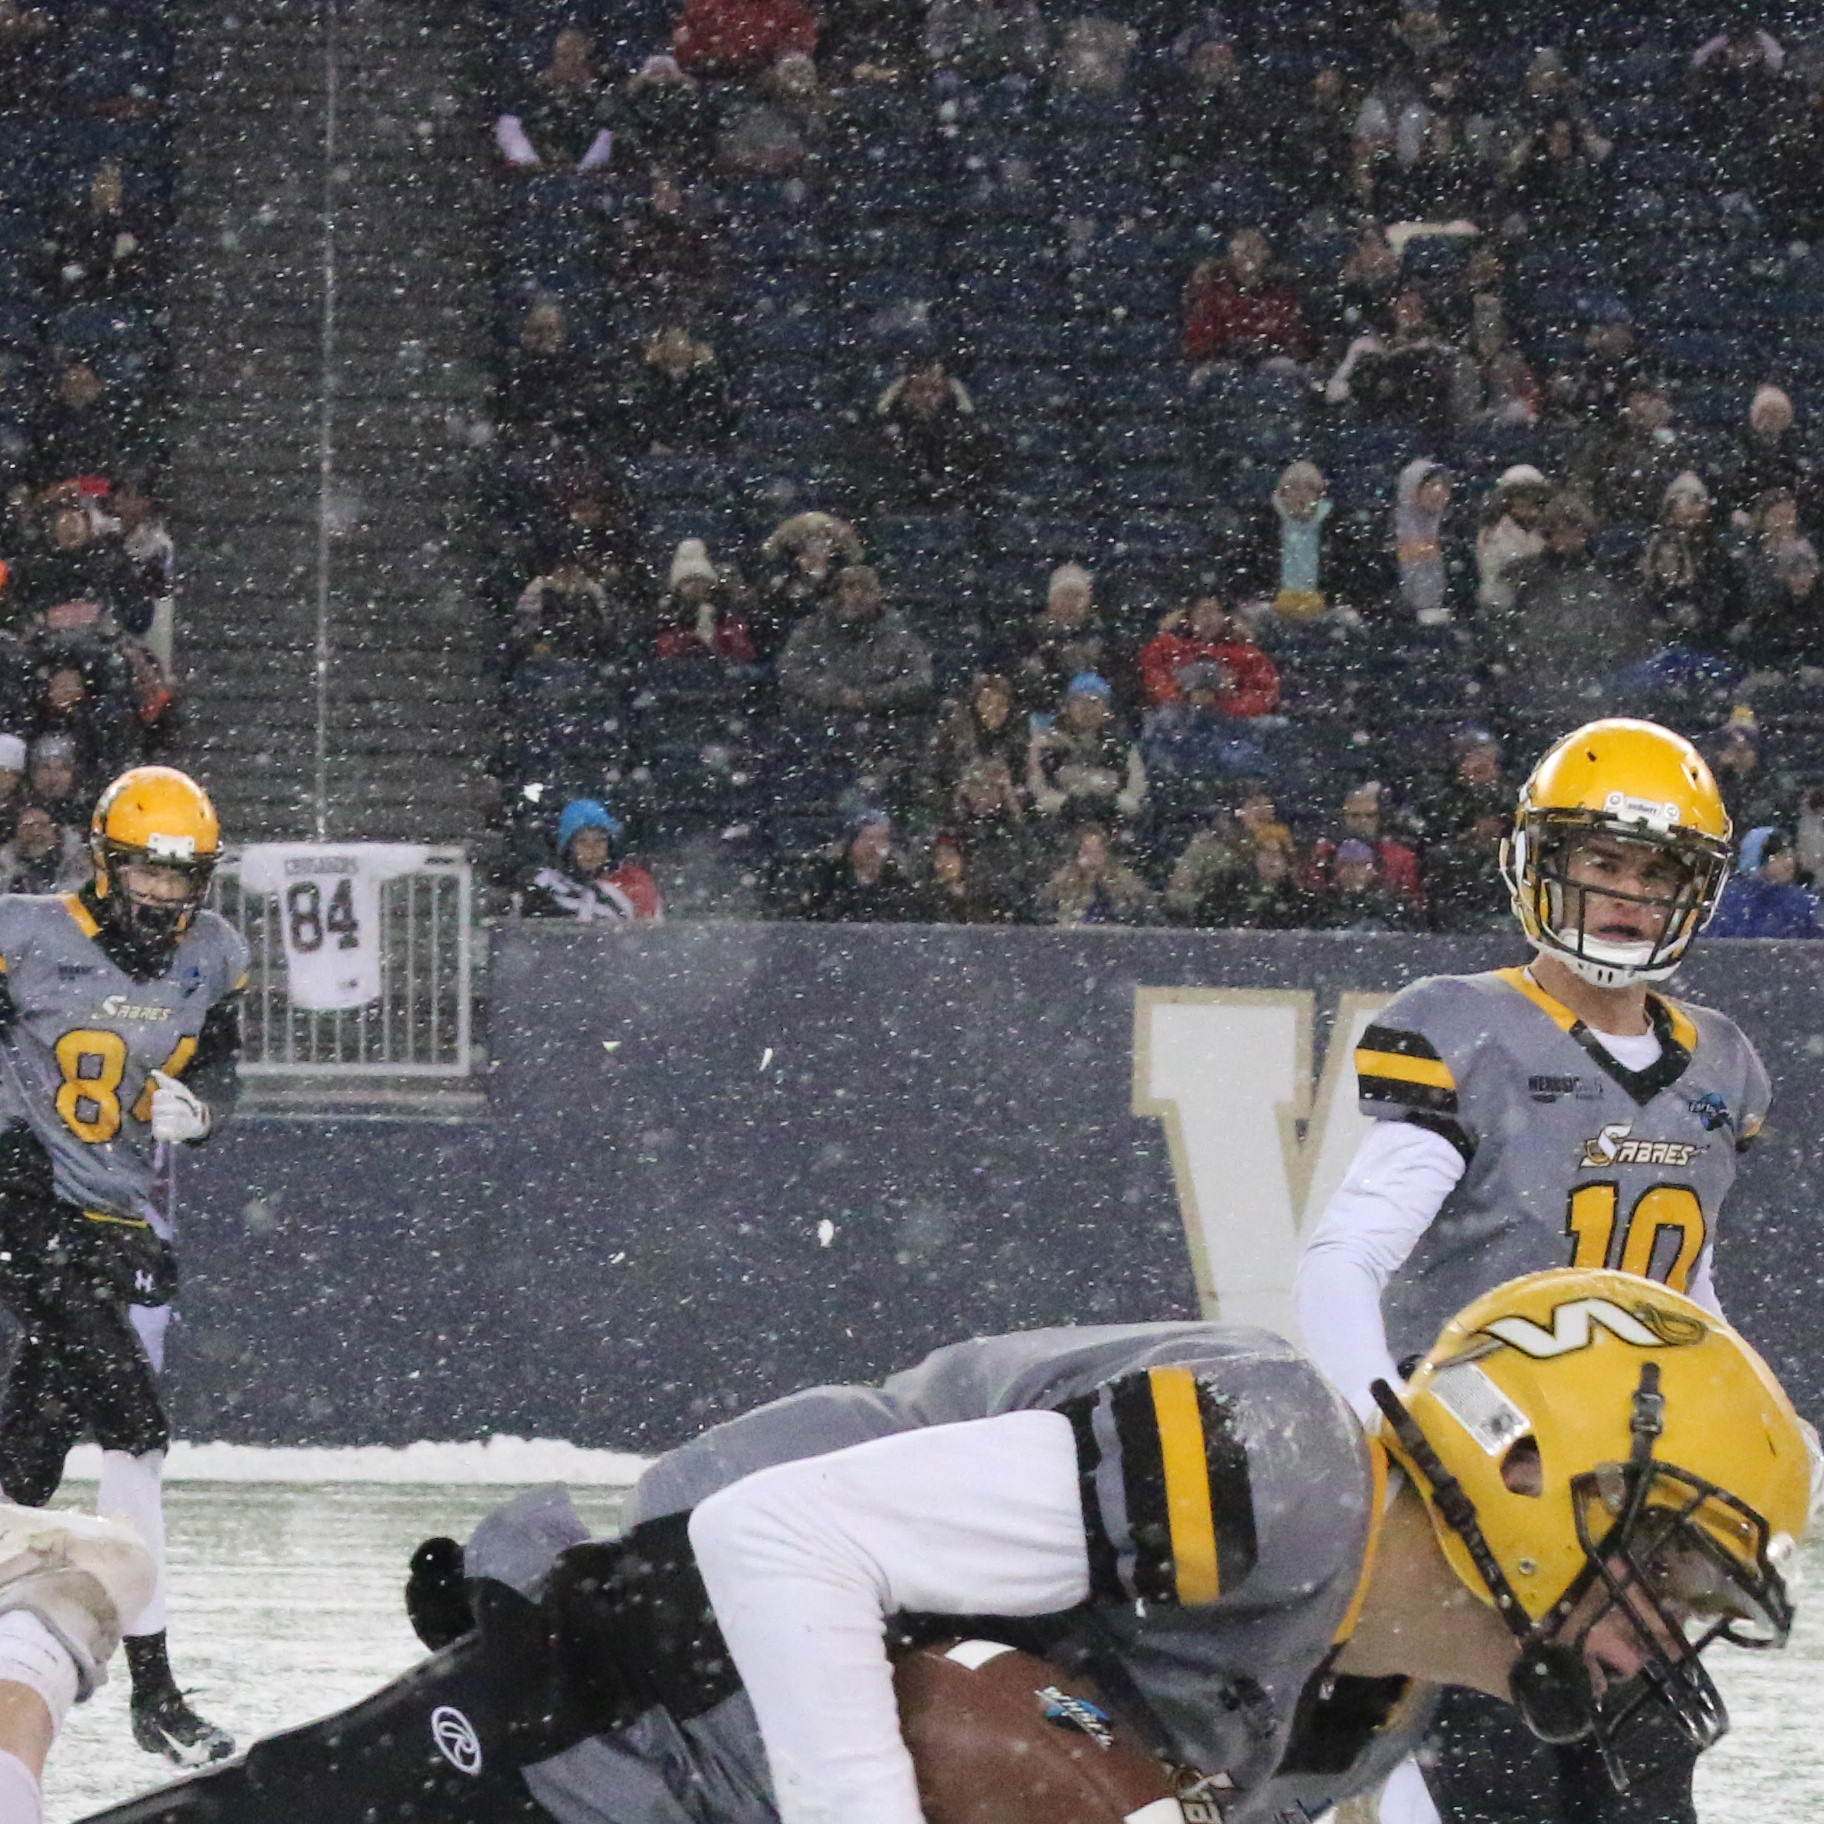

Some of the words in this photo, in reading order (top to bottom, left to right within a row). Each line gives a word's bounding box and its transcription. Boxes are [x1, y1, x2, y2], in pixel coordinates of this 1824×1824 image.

[287, 879, 360, 953] 84
[1578, 1122, 1698, 1169] SABRES
[1564, 1180, 1707, 1295] 10
